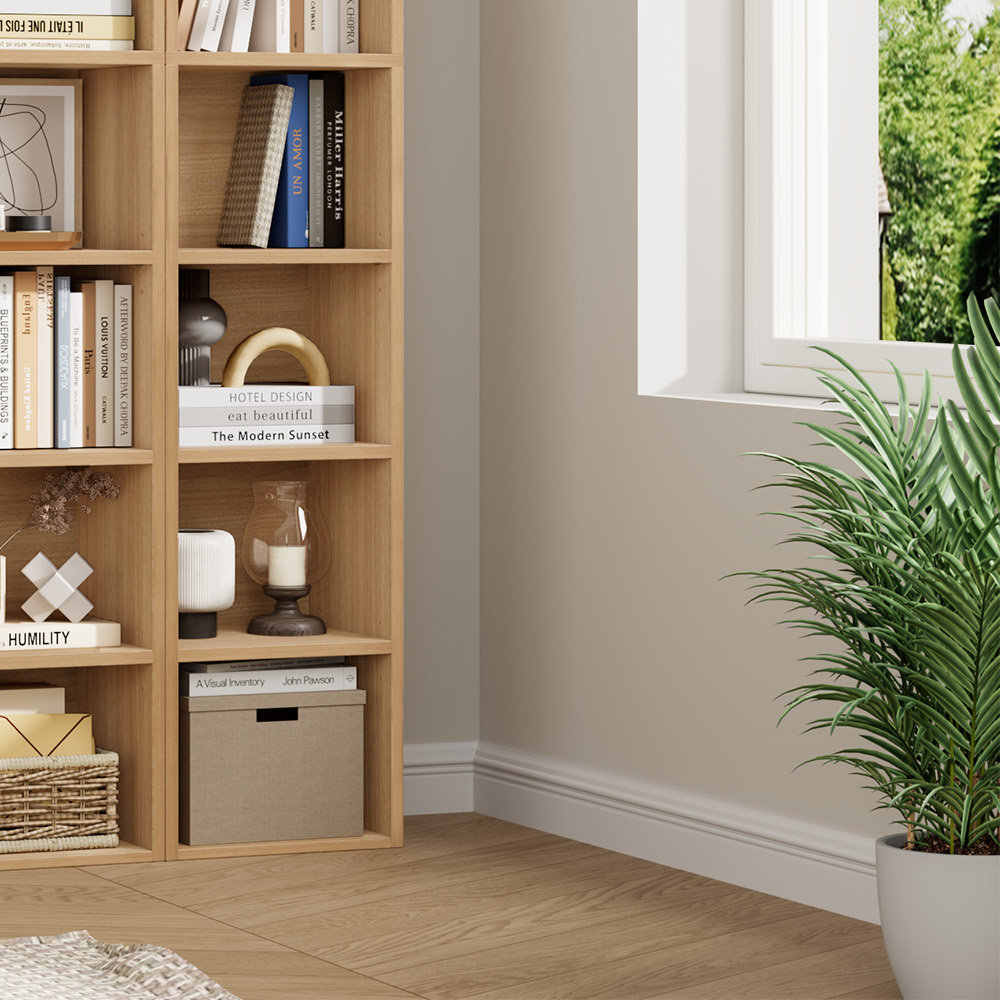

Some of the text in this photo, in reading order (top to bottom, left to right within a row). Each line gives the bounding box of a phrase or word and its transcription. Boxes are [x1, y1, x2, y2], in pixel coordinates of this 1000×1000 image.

[5, 20, 25, 32] FOIS
[28, 20, 46, 32] UNE
[75, 21, 83, 33] IL
[347, 7, 355, 45] CHOPRA
[293, 128, 302, 195] UN AMOR
[335, 110, 343, 220] Miller Harris
[0, 309, 8, 365] BLUEPRINTS
[73, 327, 80, 335] To
[73, 337, 80, 347] Be
[85, 350, 94, 375] Paris
[120, 296, 128, 436] AFTERWORD BY DEEPAK CHOPRA
[0, 376, 8, 423] BUILDINGS
[229, 392, 312, 403] HOTEL DESIGN
[228, 409, 312, 421] eat beautiful
[212, 429, 330, 442] The Modern Sunset
[8, 631, 70, 646] HUMILITY
[196, 676, 334, 688] A Visual Inventory John Pawson
